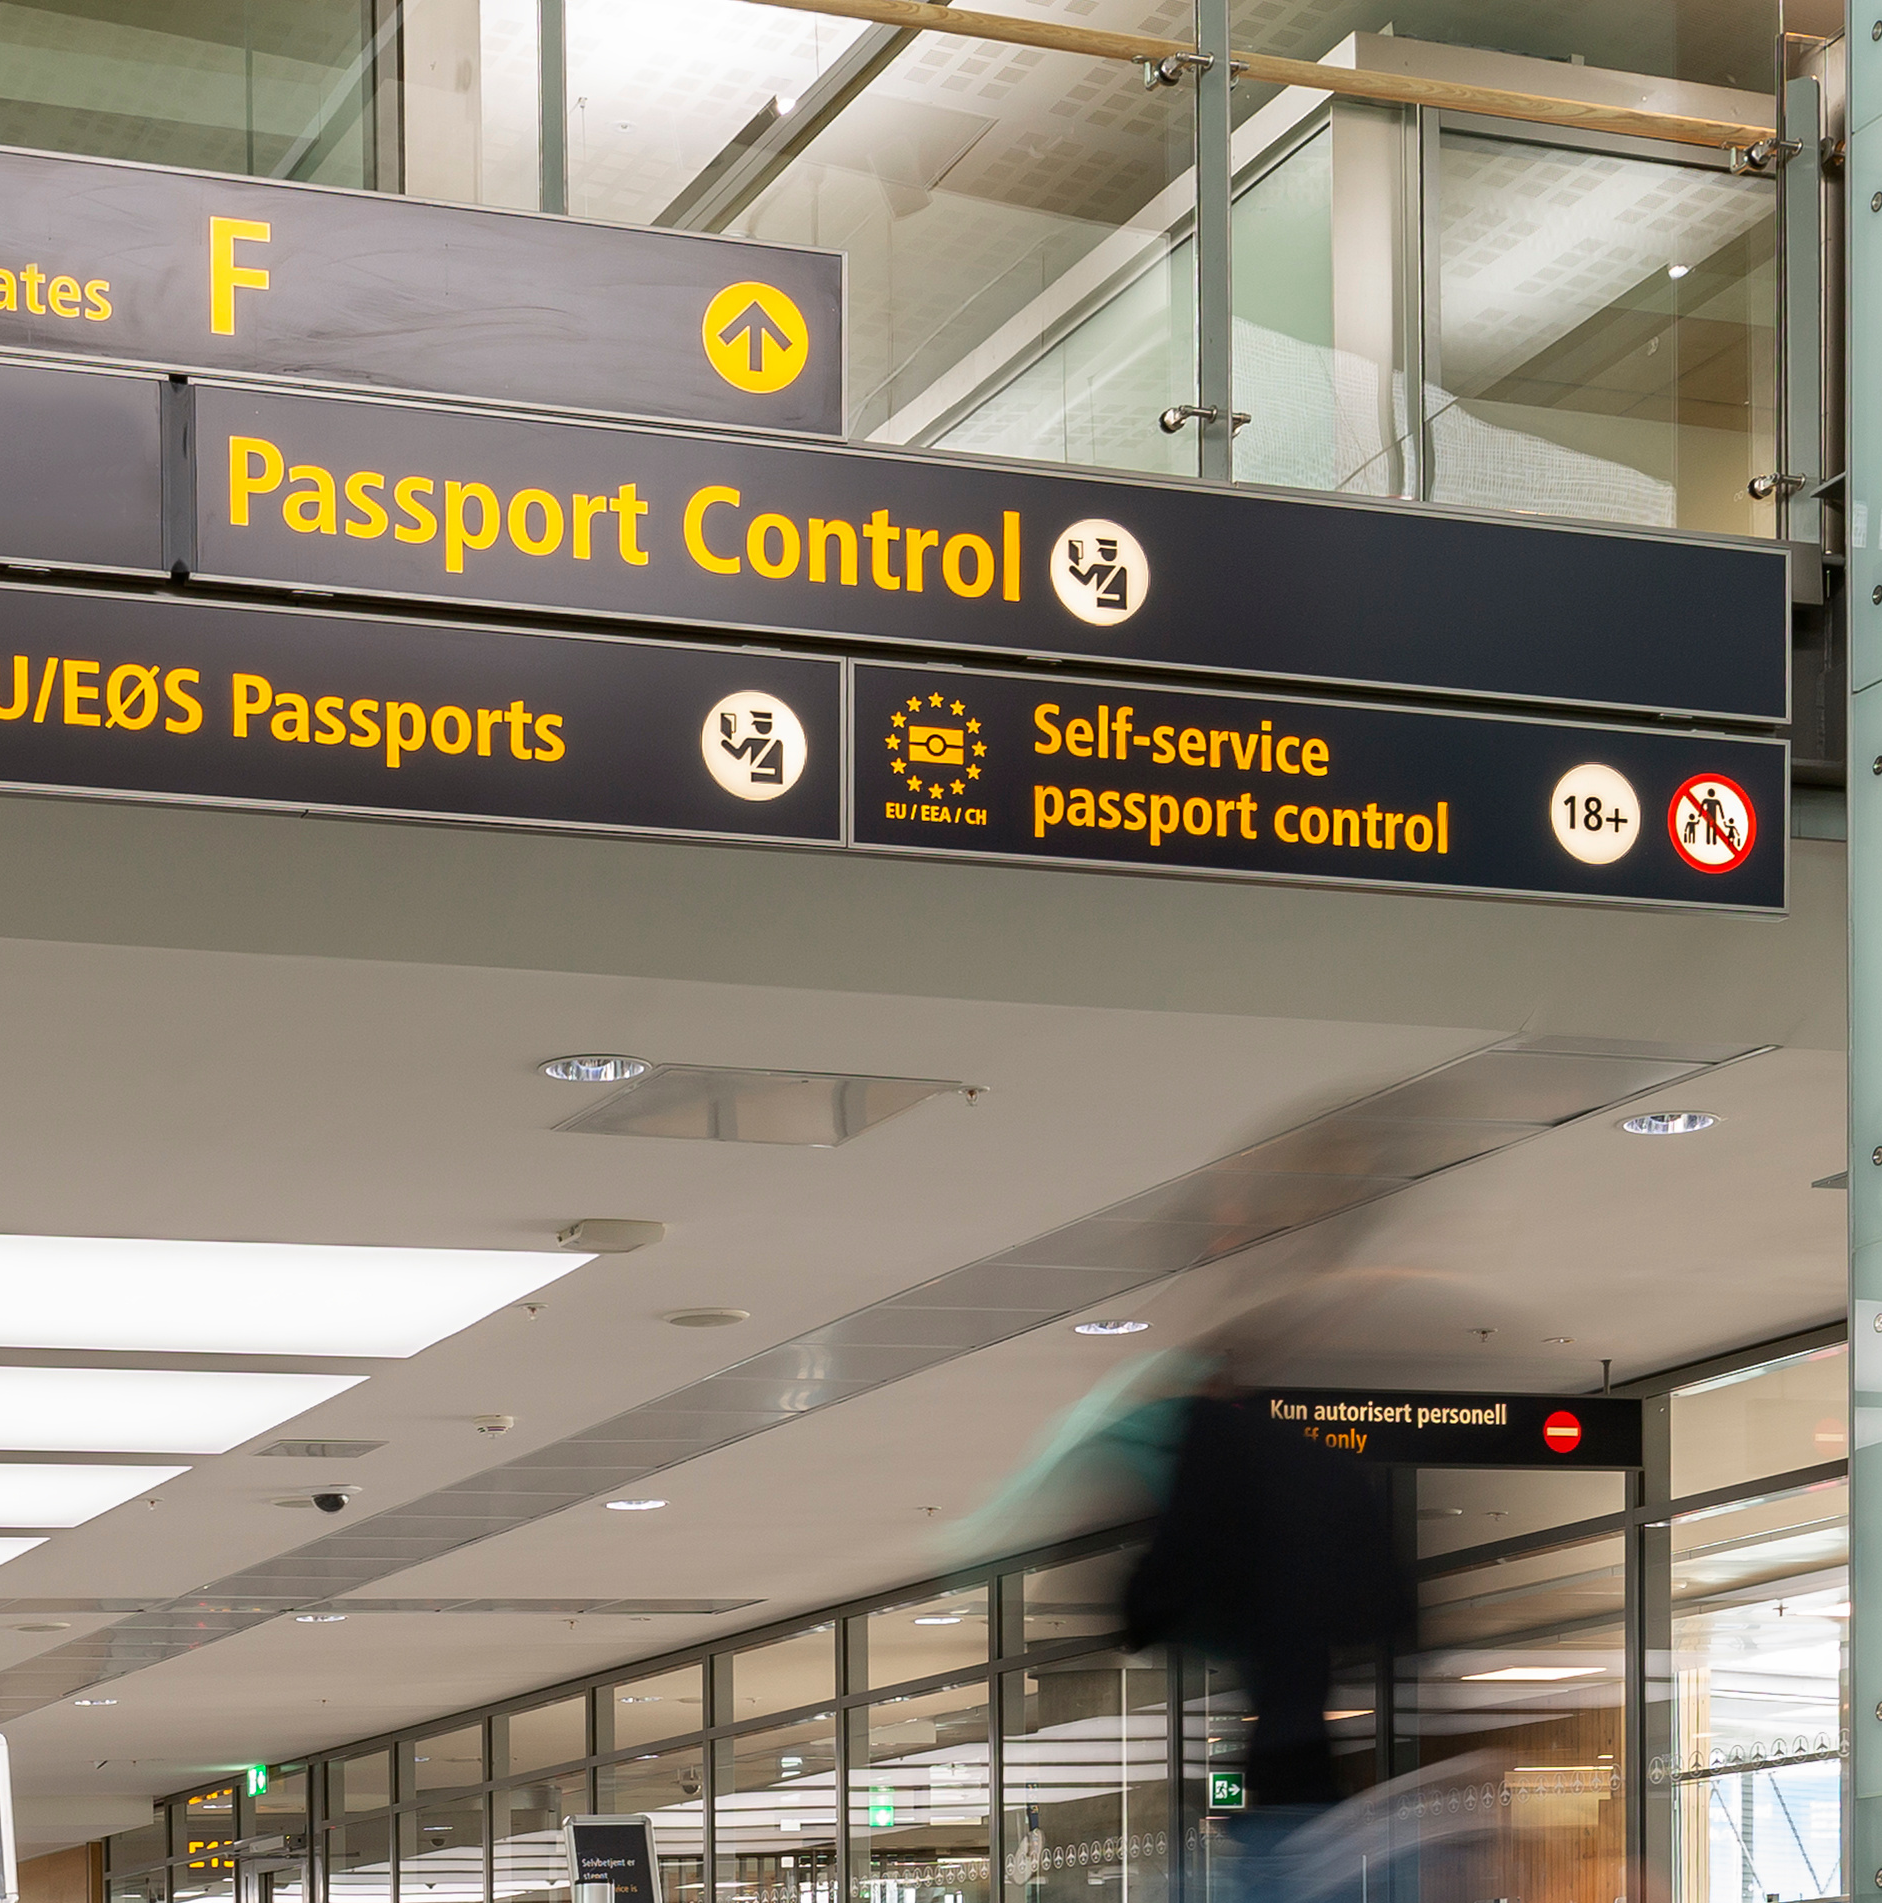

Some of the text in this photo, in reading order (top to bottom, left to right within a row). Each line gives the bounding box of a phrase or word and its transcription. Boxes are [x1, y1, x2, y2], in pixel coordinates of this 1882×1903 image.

[209, 215, 270, 336] F
[228, 435, 1021, 602] Passport Control
[231, 672, 566, 769] Passports
[1033, 702, 1331, 777] Self-service
[885, 801, 988, 826] EU / EEA / CH
[1033, 784, 1450, 855] passport control
[1563, 794, 1629, 834] 18+
[1270, 1399, 1508, 1429] Kun autorisert personell
[1324, 1427, 1369, 1454] only
[580, 1857, 636, 1869] Selvbetjent er
